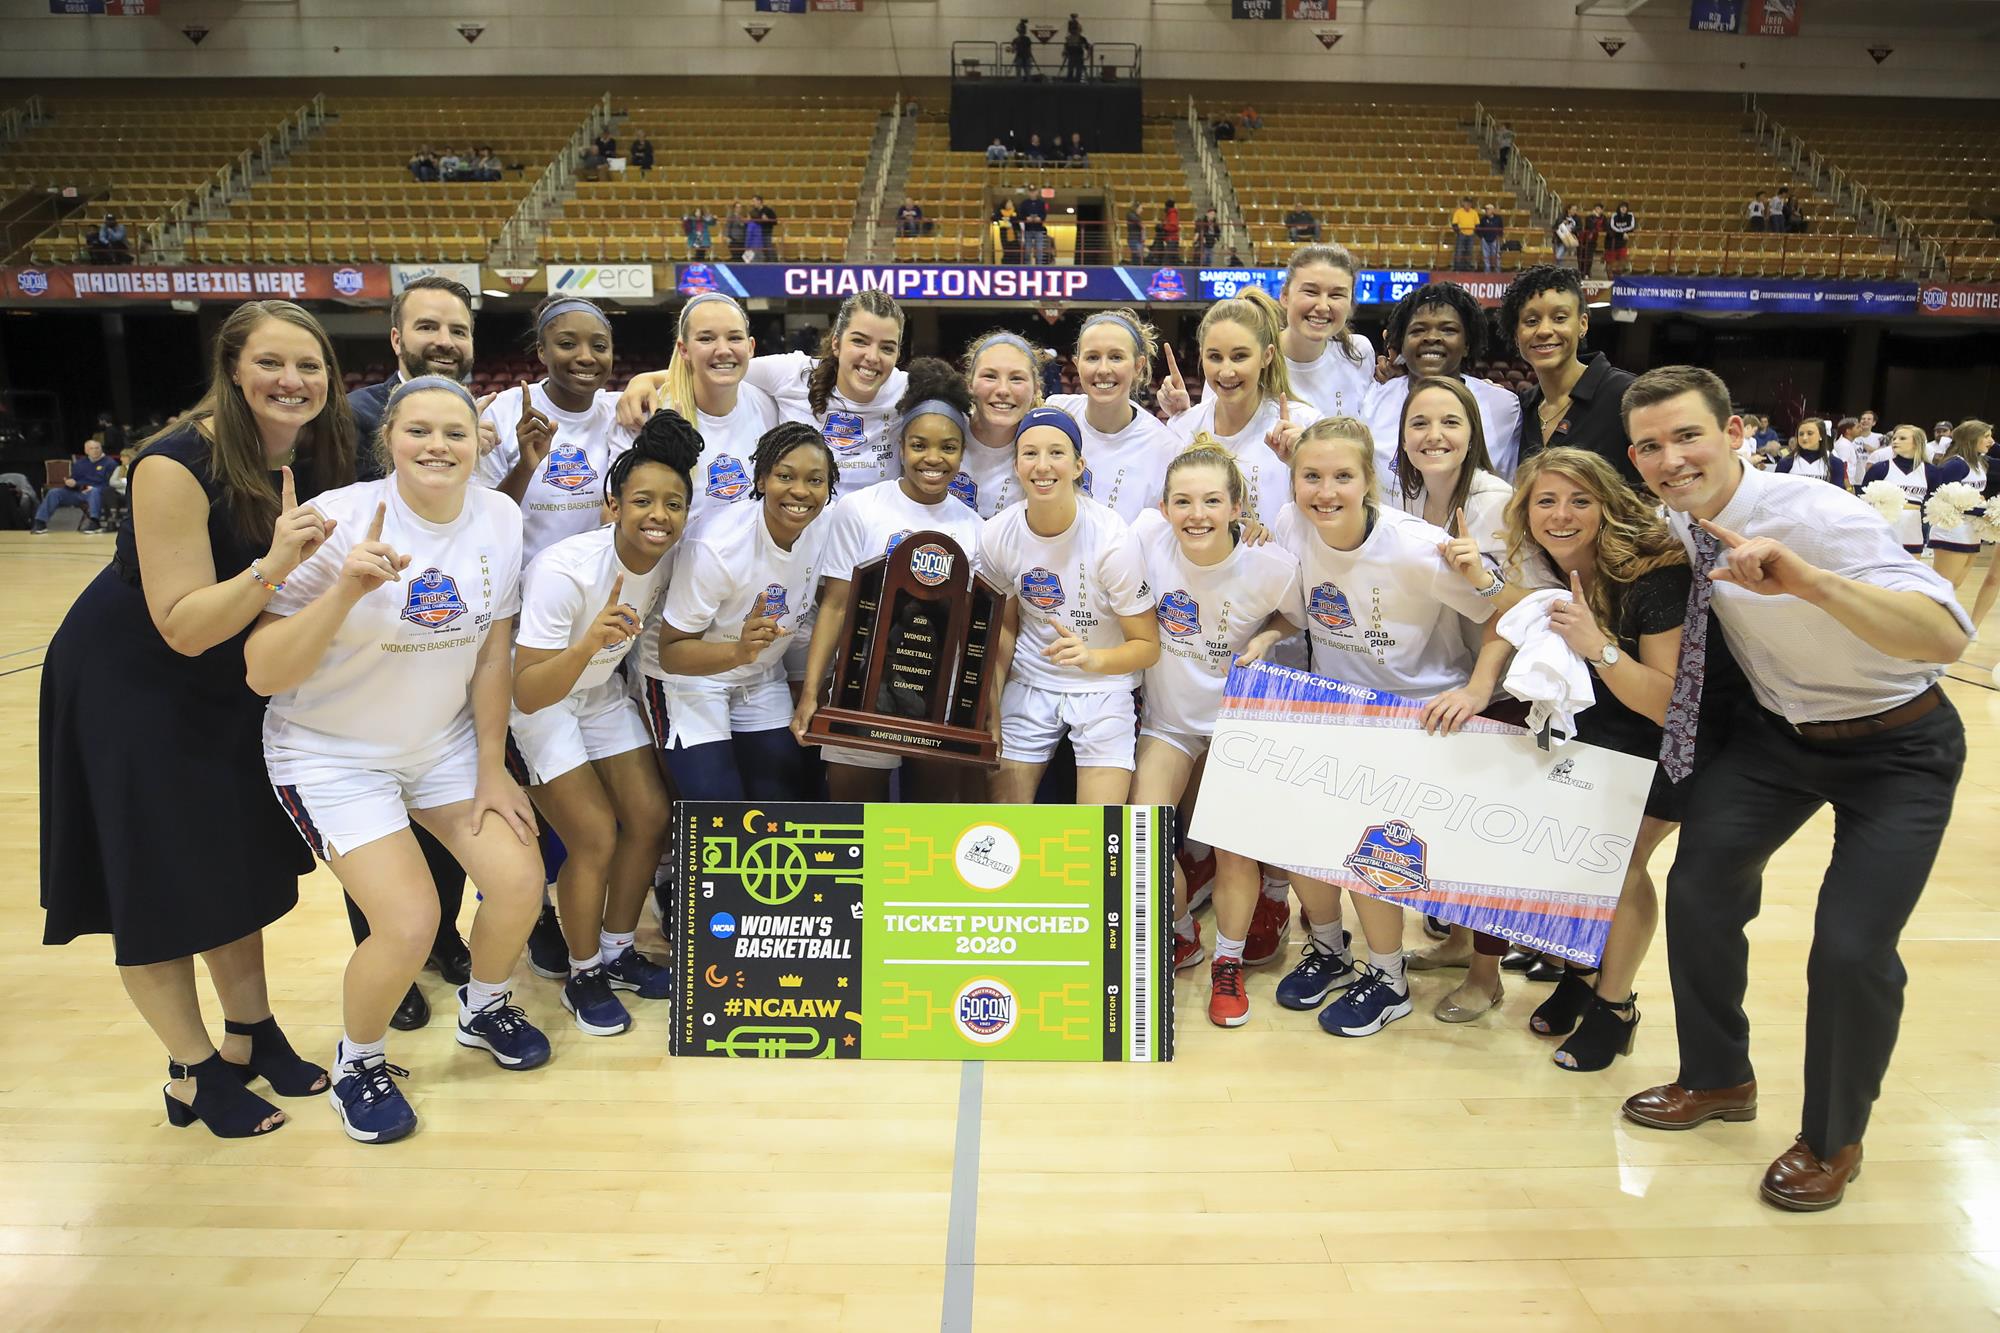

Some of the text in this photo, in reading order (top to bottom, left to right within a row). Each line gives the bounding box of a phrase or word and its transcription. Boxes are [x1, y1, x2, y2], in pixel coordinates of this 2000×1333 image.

[72, 272, 306, 298] MADNESS BEGINS HERE
[597, 267, 645, 289] erc
[784, 268, 1088, 296] CHAMPIONSHIP
[1199, 271, 1251, 282] SAMFORD
[1390, 272, 1418, 282] UNCG
[1213, 281, 1236, 298] 59
[1586, 288, 1599, 296] 107
[1612, 286, 1637, 297] FOLLOW
[1923, 290, 1947, 306] SOCON
[529, 502, 566, 512] WOMEN'S
[911, 550, 953, 575] SOCON
[420, 593, 449, 605] ingles
[913, 616, 927, 625] 2020
[1070, 609, 1092, 618] 2019
[1075, 619, 1099, 627] 2020
[903, 631, 932, 643] WOMEN'S
[1364, 630, 1388, 639] 2019
[1370, 639, 1396, 648] 2020
[380, 635, 477, 653] WOMEN'S BASKETBALL
[1167, 643, 1208, 662] BASKETBALL
[1205, 640, 1228, 650] 2019
[1208, 649, 1232, 657] 2020
[1328, 640, 1372, 655] BASKETBALL
[896, 647, 933, 660] BASKETBALL
[892, 663, 932, 676] TOURNAMENT
[893, 680, 924, 692] CHAMPION
[1217, 709, 1284, 722] SOUTHERN
[1286, 711, 1371, 727] CONFERENCE
[870, 730, 942, 748] SAMFORD UNVERSITY
[1547, 773, 1594, 791] SAMFORD
[1211, 731, 1631, 874] CHAMPIONS
[1383, 821, 1414, 844] SOCON
[1107, 833, 1119, 854] 20
[963, 851, 1013, 875] SAMFORD
[1372, 845, 1411, 867] ingles
[1353, 856, 1423, 883] BASKETBALL CHAMPIONSHIPS
[1439, 881, 1617, 907] SOUTHERN CONFERENCE
[685, 815, 698, 1043] NCAA TOURNAMENT AUTOMATIC QUALIFIER
[712, 923, 736, 932] NCAA
[740, 915, 833, 937] WOMEN'S
[883, 914, 1090, 934] TICKET PUNCHED
[1107, 912, 1119, 928] 16
[735, 938, 852, 959] BASKETBALL
[956, 936, 1017, 954] 2020
[1484, 922, 1597, 964] #SOCONHOOPS
[723, 998, 842, 1017] #NCAAW
[961, 995, 1011, 1023] SOCON
[1107, 985, 1119, 1033] SECTION 3
